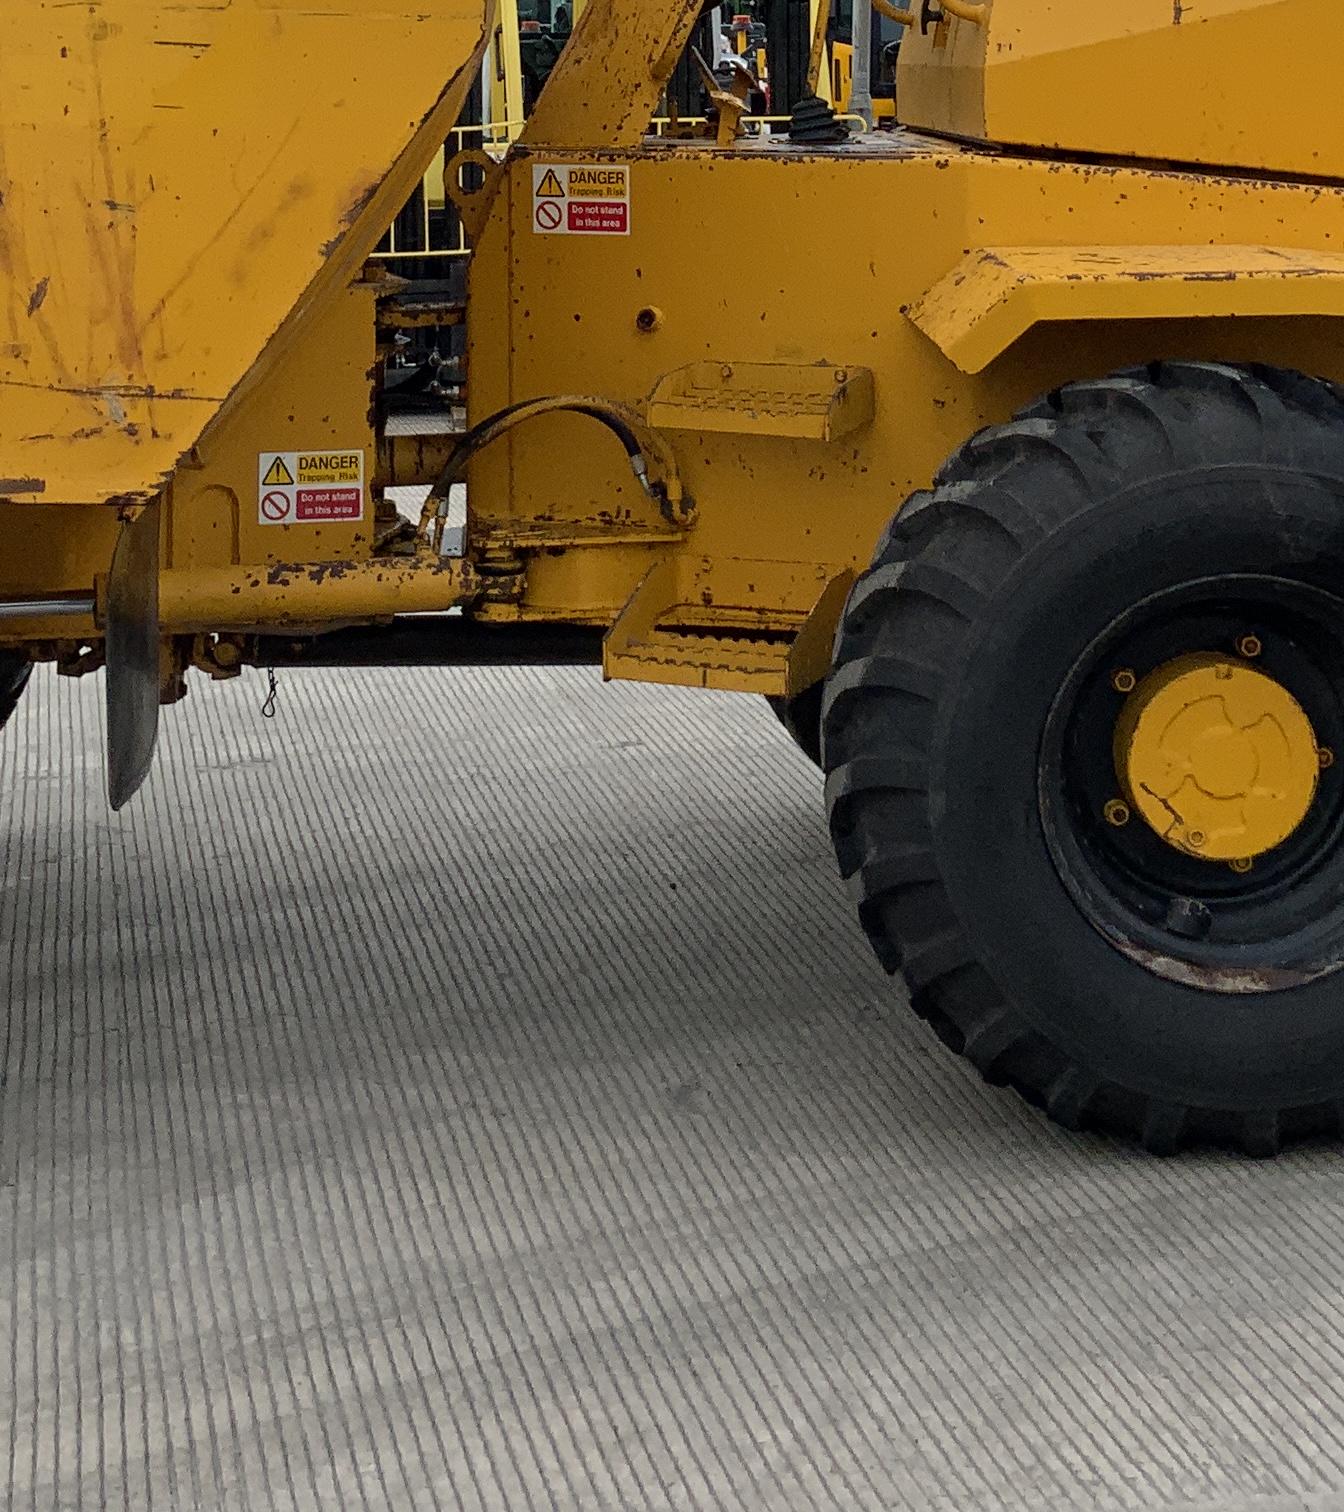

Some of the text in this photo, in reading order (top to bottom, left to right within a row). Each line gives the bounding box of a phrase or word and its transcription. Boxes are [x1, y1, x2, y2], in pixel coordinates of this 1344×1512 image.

[569, 171, 625, 184] DANGER
[569, 187, 625, 197] Trapping Risk
[571, 205, 624, 214] Do not stand
[576, 218, 621, 227] in this area
[299, 456, 359, 470] DANGER
[299, 472, 358, 482] Trapping Risk
[301, 492, 356, 502] Do not stand
[305, 506, 353, 514] in this area
